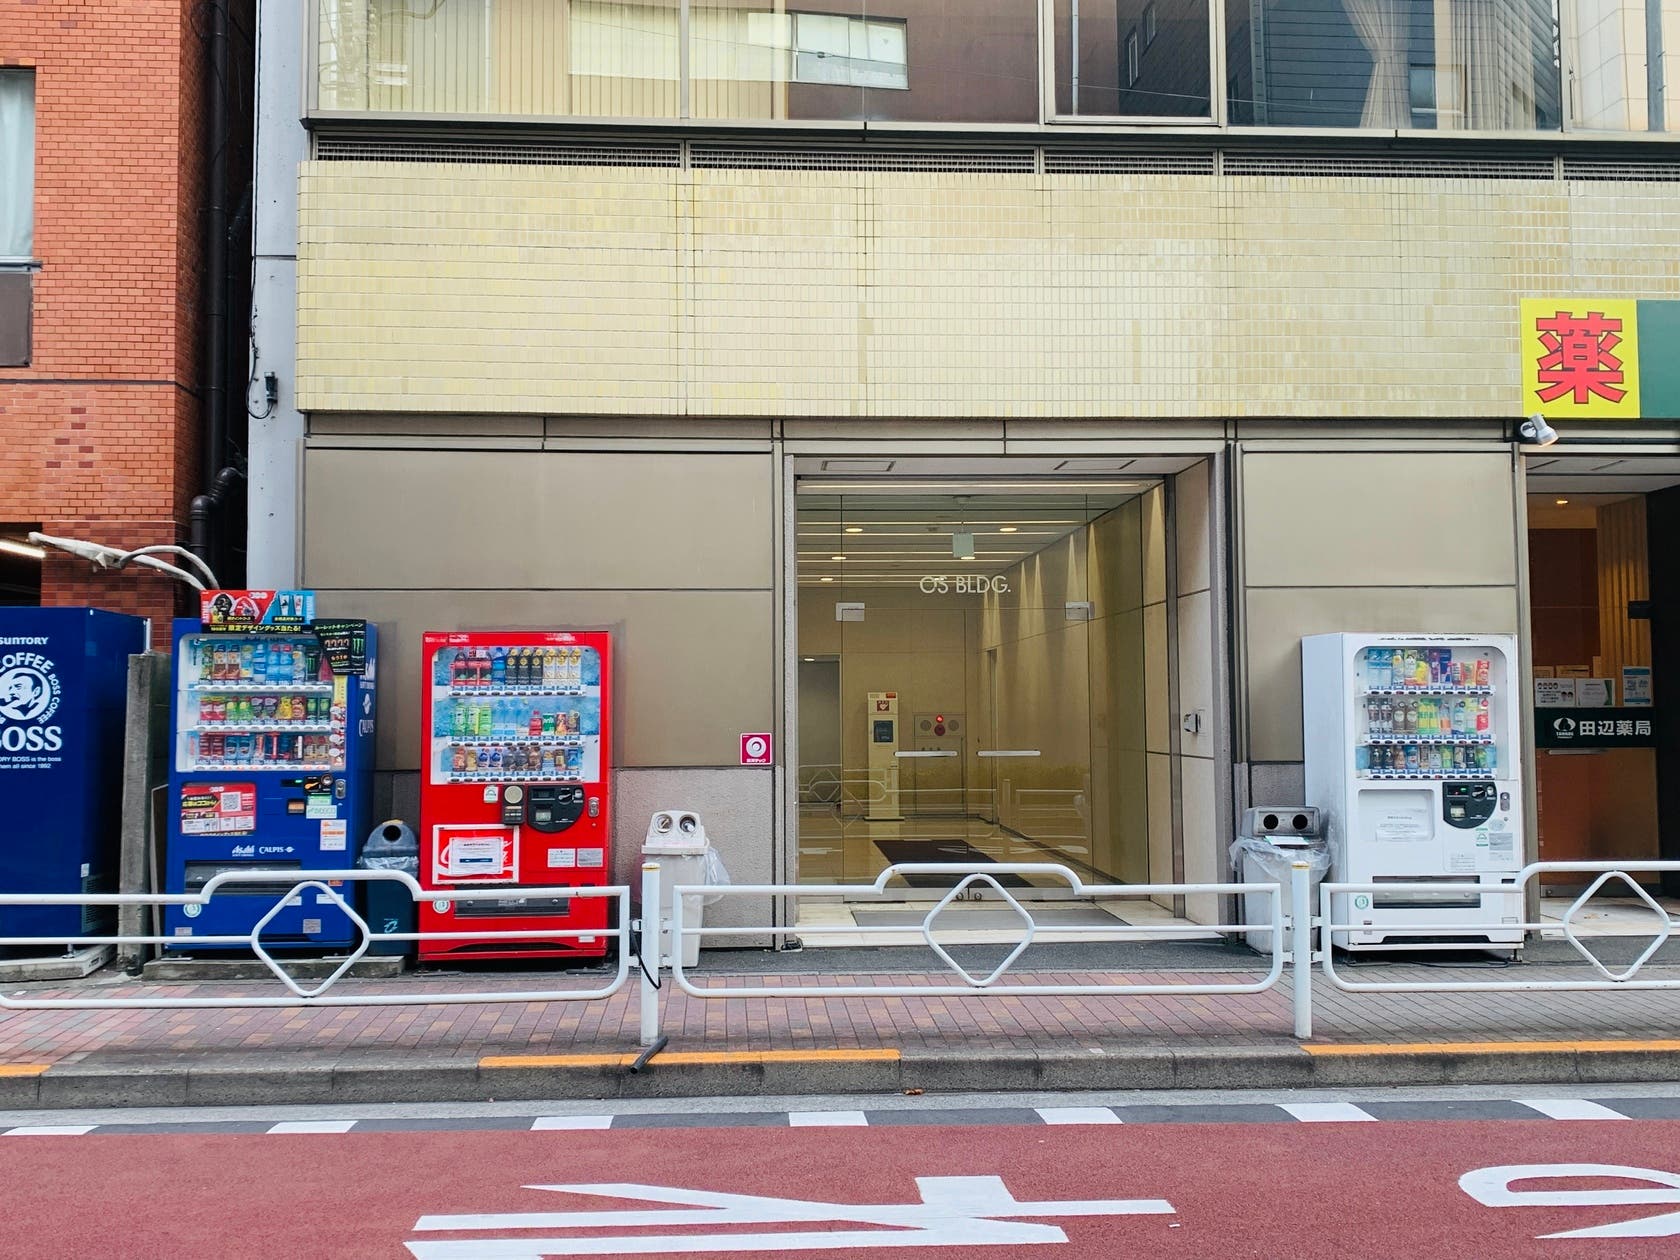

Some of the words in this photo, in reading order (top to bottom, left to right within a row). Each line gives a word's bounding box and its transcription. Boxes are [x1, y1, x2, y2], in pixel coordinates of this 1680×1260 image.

[1534, 311, 1628, 404] 薬
[920, 575, 949, 594] OS
[955, 574, 1012, 594] BLDG.
[48, 673, 61, 695] BOSS
[37, 696, 60, 724] COFFEE
[0, 726, 62, 752] OSS
[1579, 720, 1651, 736] 田辺薬局
[232, 845, 255, 854] Asahi
[259, 846, 284, 855] CALPIS
